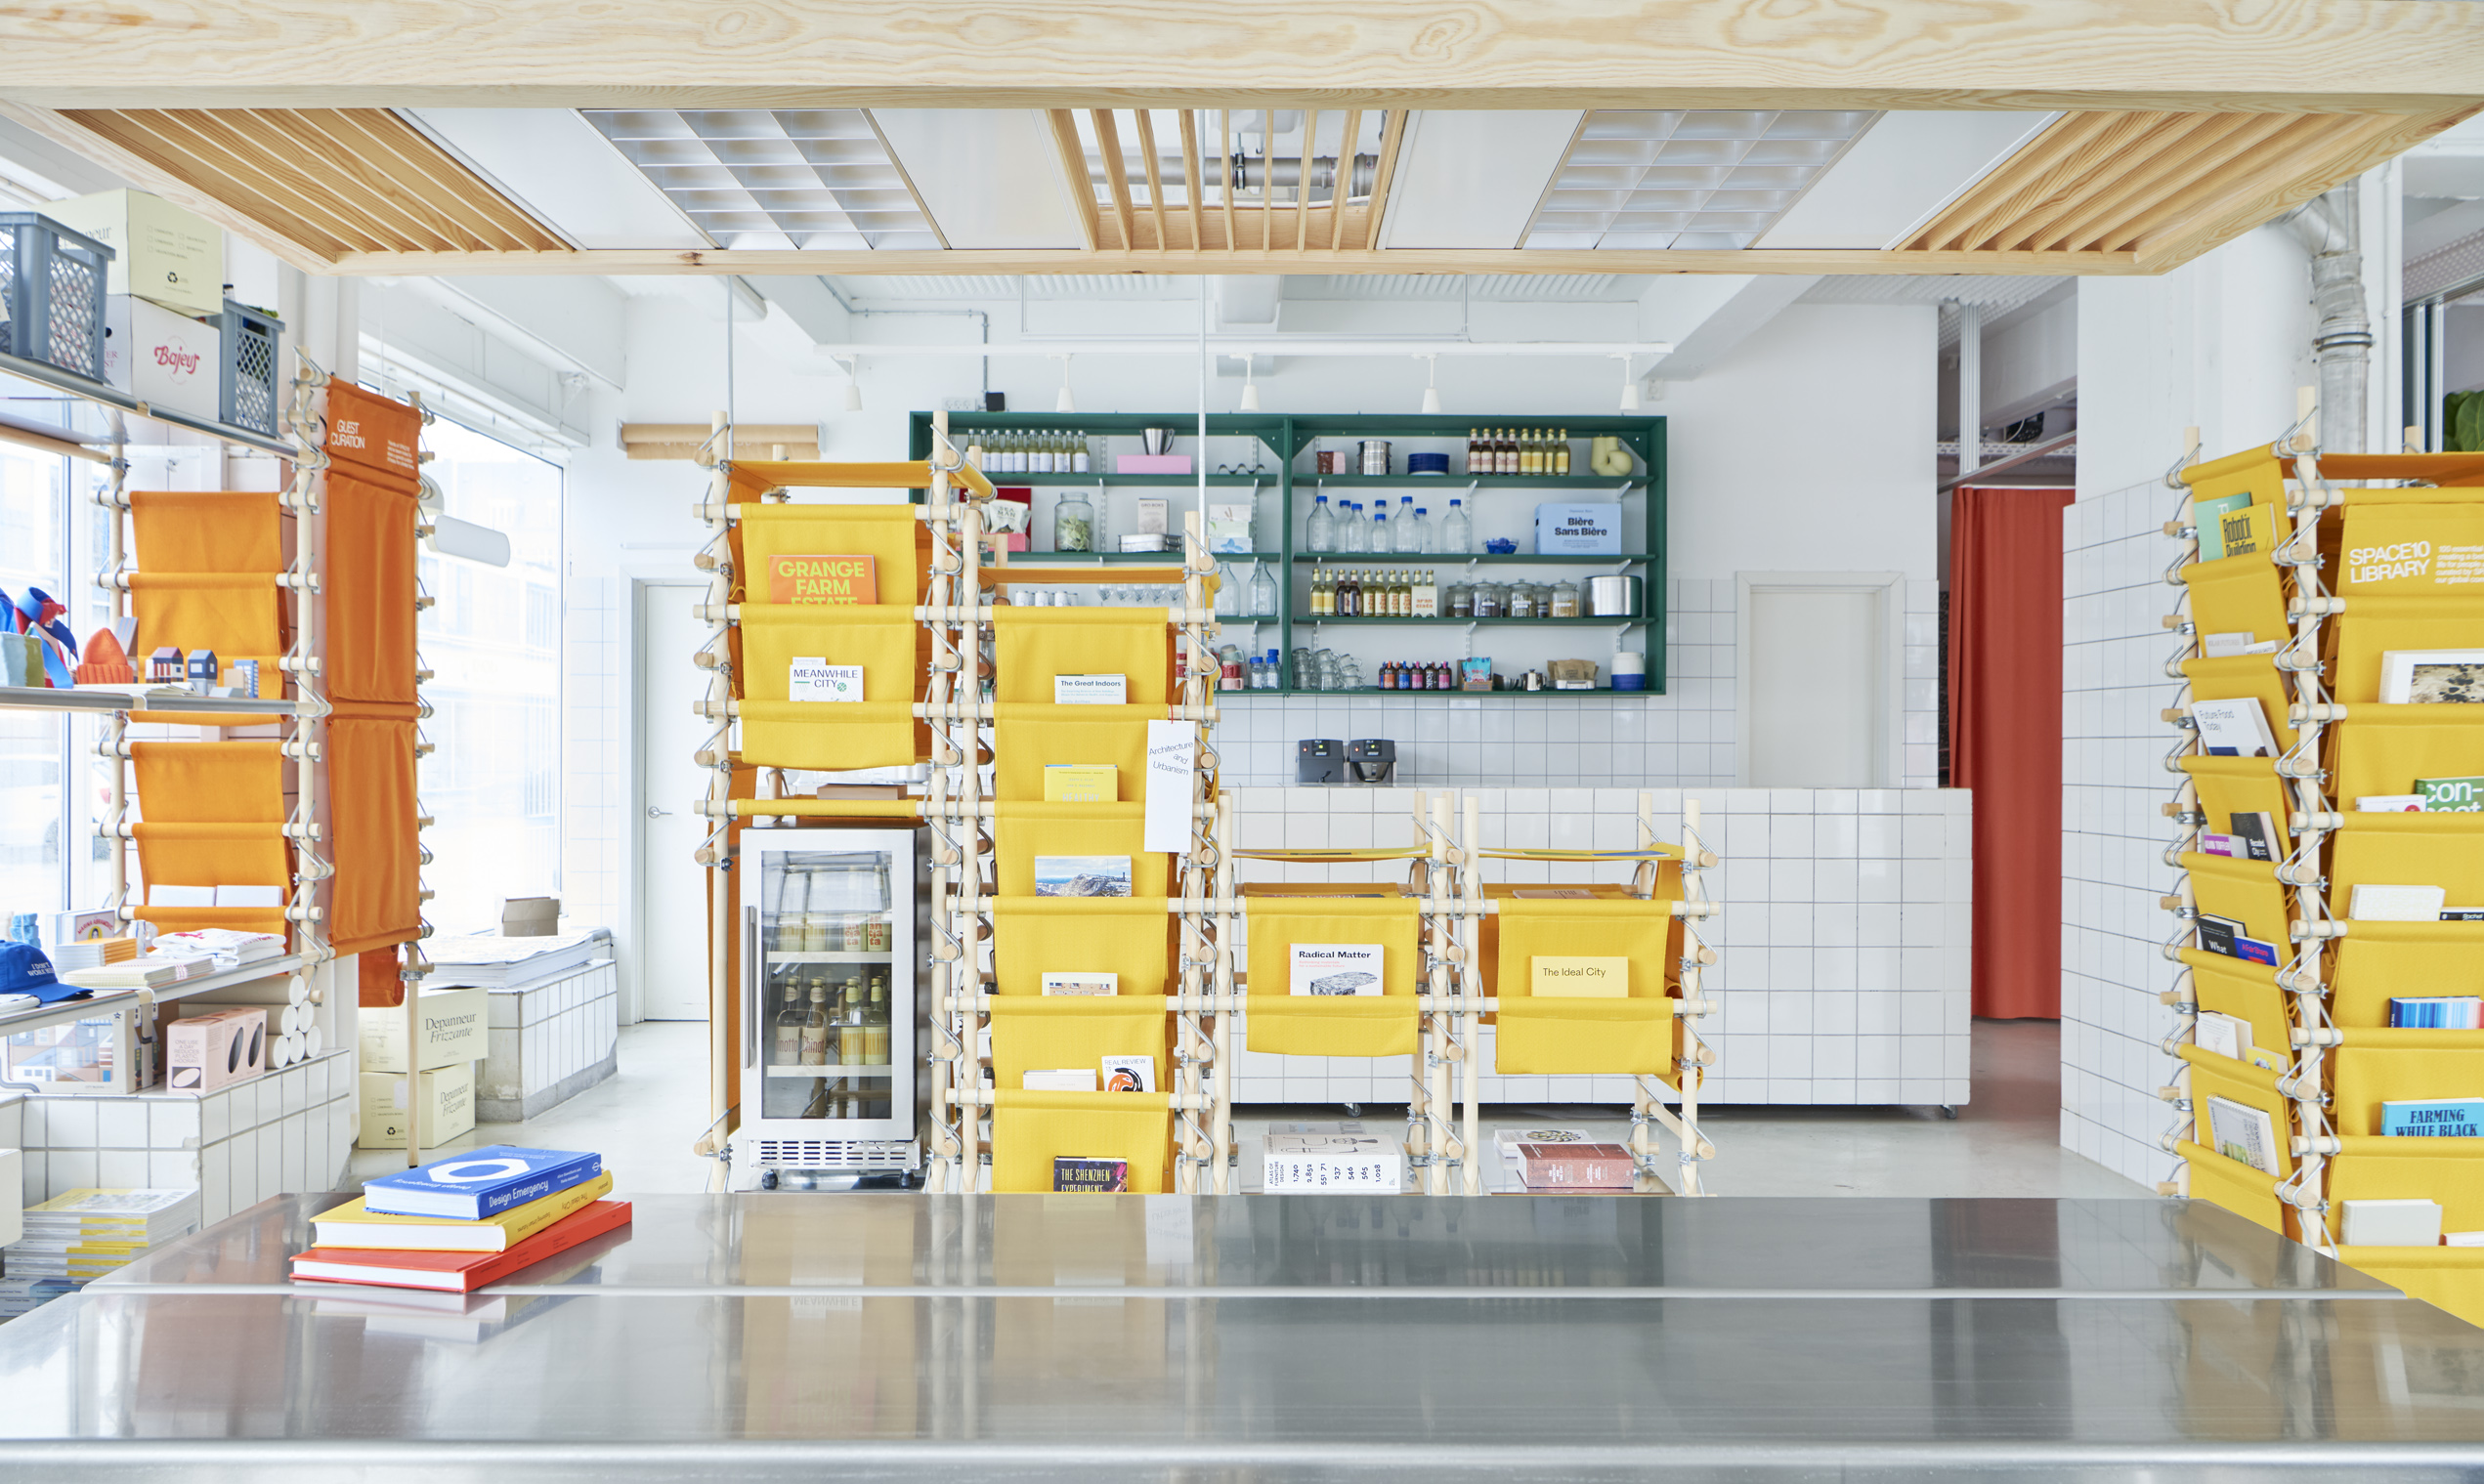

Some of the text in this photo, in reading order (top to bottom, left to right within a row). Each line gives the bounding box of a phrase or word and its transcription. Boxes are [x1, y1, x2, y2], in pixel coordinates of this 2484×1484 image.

[336, 419, 360, 435] GUEST
[330, 432, 365, 448] CURATION
[1567, 517, 1595, 526] Bière
[2222, 514, 2252, 543] Robotic
[1555, 527, 1607, 536] Sans Bière
[2349, 540, 2430, 566] SPACE10
[778, 562, 865, 577] GRANGE
[2350, 559, 2430, 583] LIBRARY
[795, 579, 851, 595] FARM
[793, 669, 858, 678] MEANWHILE
[814, 679, 837, 688] CITY
[1148, 741, 1194, 756] Architecture
[1173, 753, 1188, 765] and
[1152, 761, 1189, 776] Urbanism
[2426, 782, 2484, 803] con-
[2208, 940, 2228, 954] What
[1543, 967, 1606, 979] The Ideal City
[425, 1013, 477, 1032] Depanneur
[430, 1027, 473, 1043] Frizzante
[440, 1082, 469, 1105] Depanneur
[443, 1097, 467, 1117] Frizzante
[2410, 1109, 2464, 1124] FARMING
[2395, 1124, 2478, 1136] WHILE BLACK
[1320, 1163, 1327, 1171] 71
[1061, 1168, 1110, 1182] THE SHENZHEN
[489, 1179, 549, 1208] Design Emergency
